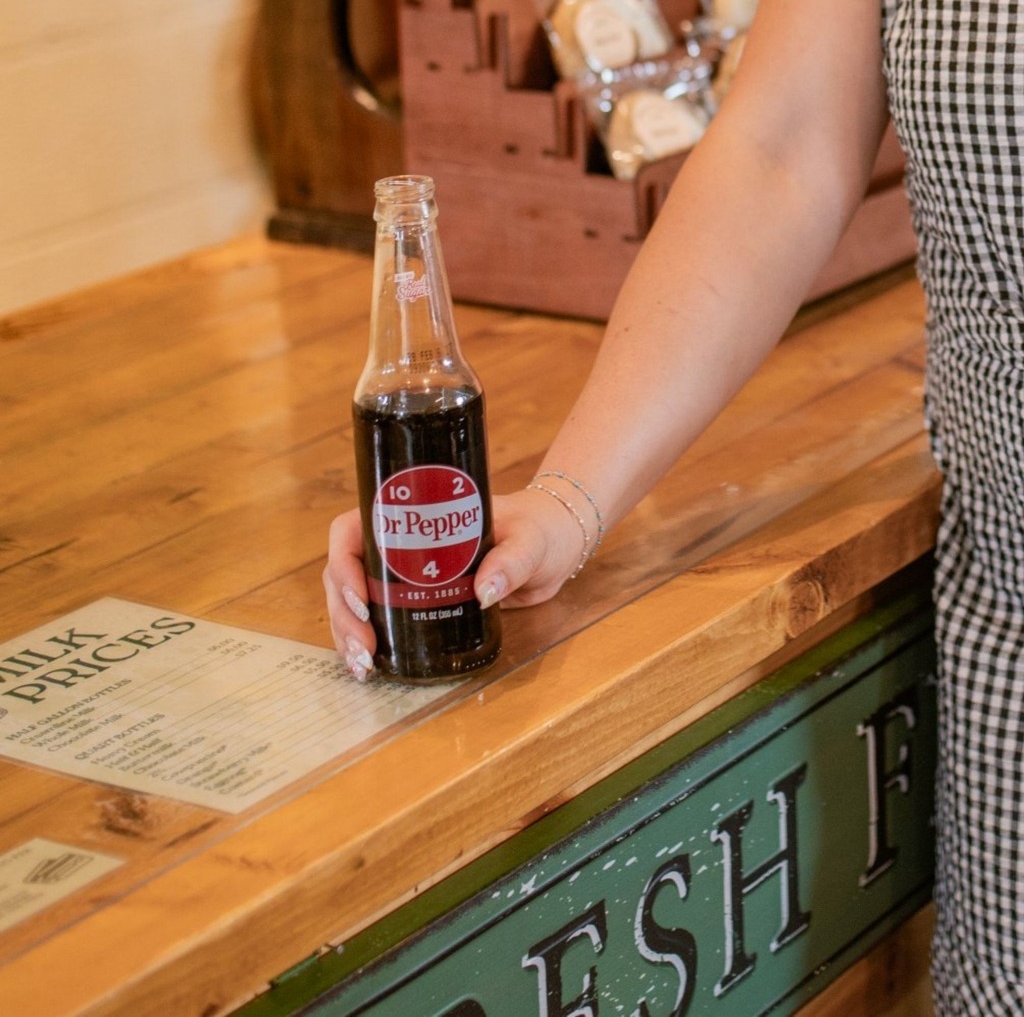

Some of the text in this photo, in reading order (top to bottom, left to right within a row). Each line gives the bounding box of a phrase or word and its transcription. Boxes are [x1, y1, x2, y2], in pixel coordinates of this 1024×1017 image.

[389, 476, 465, 501] 10 2
[376, 505, 480, 542] Dr Pepper
[422, 560, 440, 579] 4
[407, 586, 460, 600] EST. 1885
[412, 612, 420, 621] 12
[2, 617, 196, 704] PRICES
